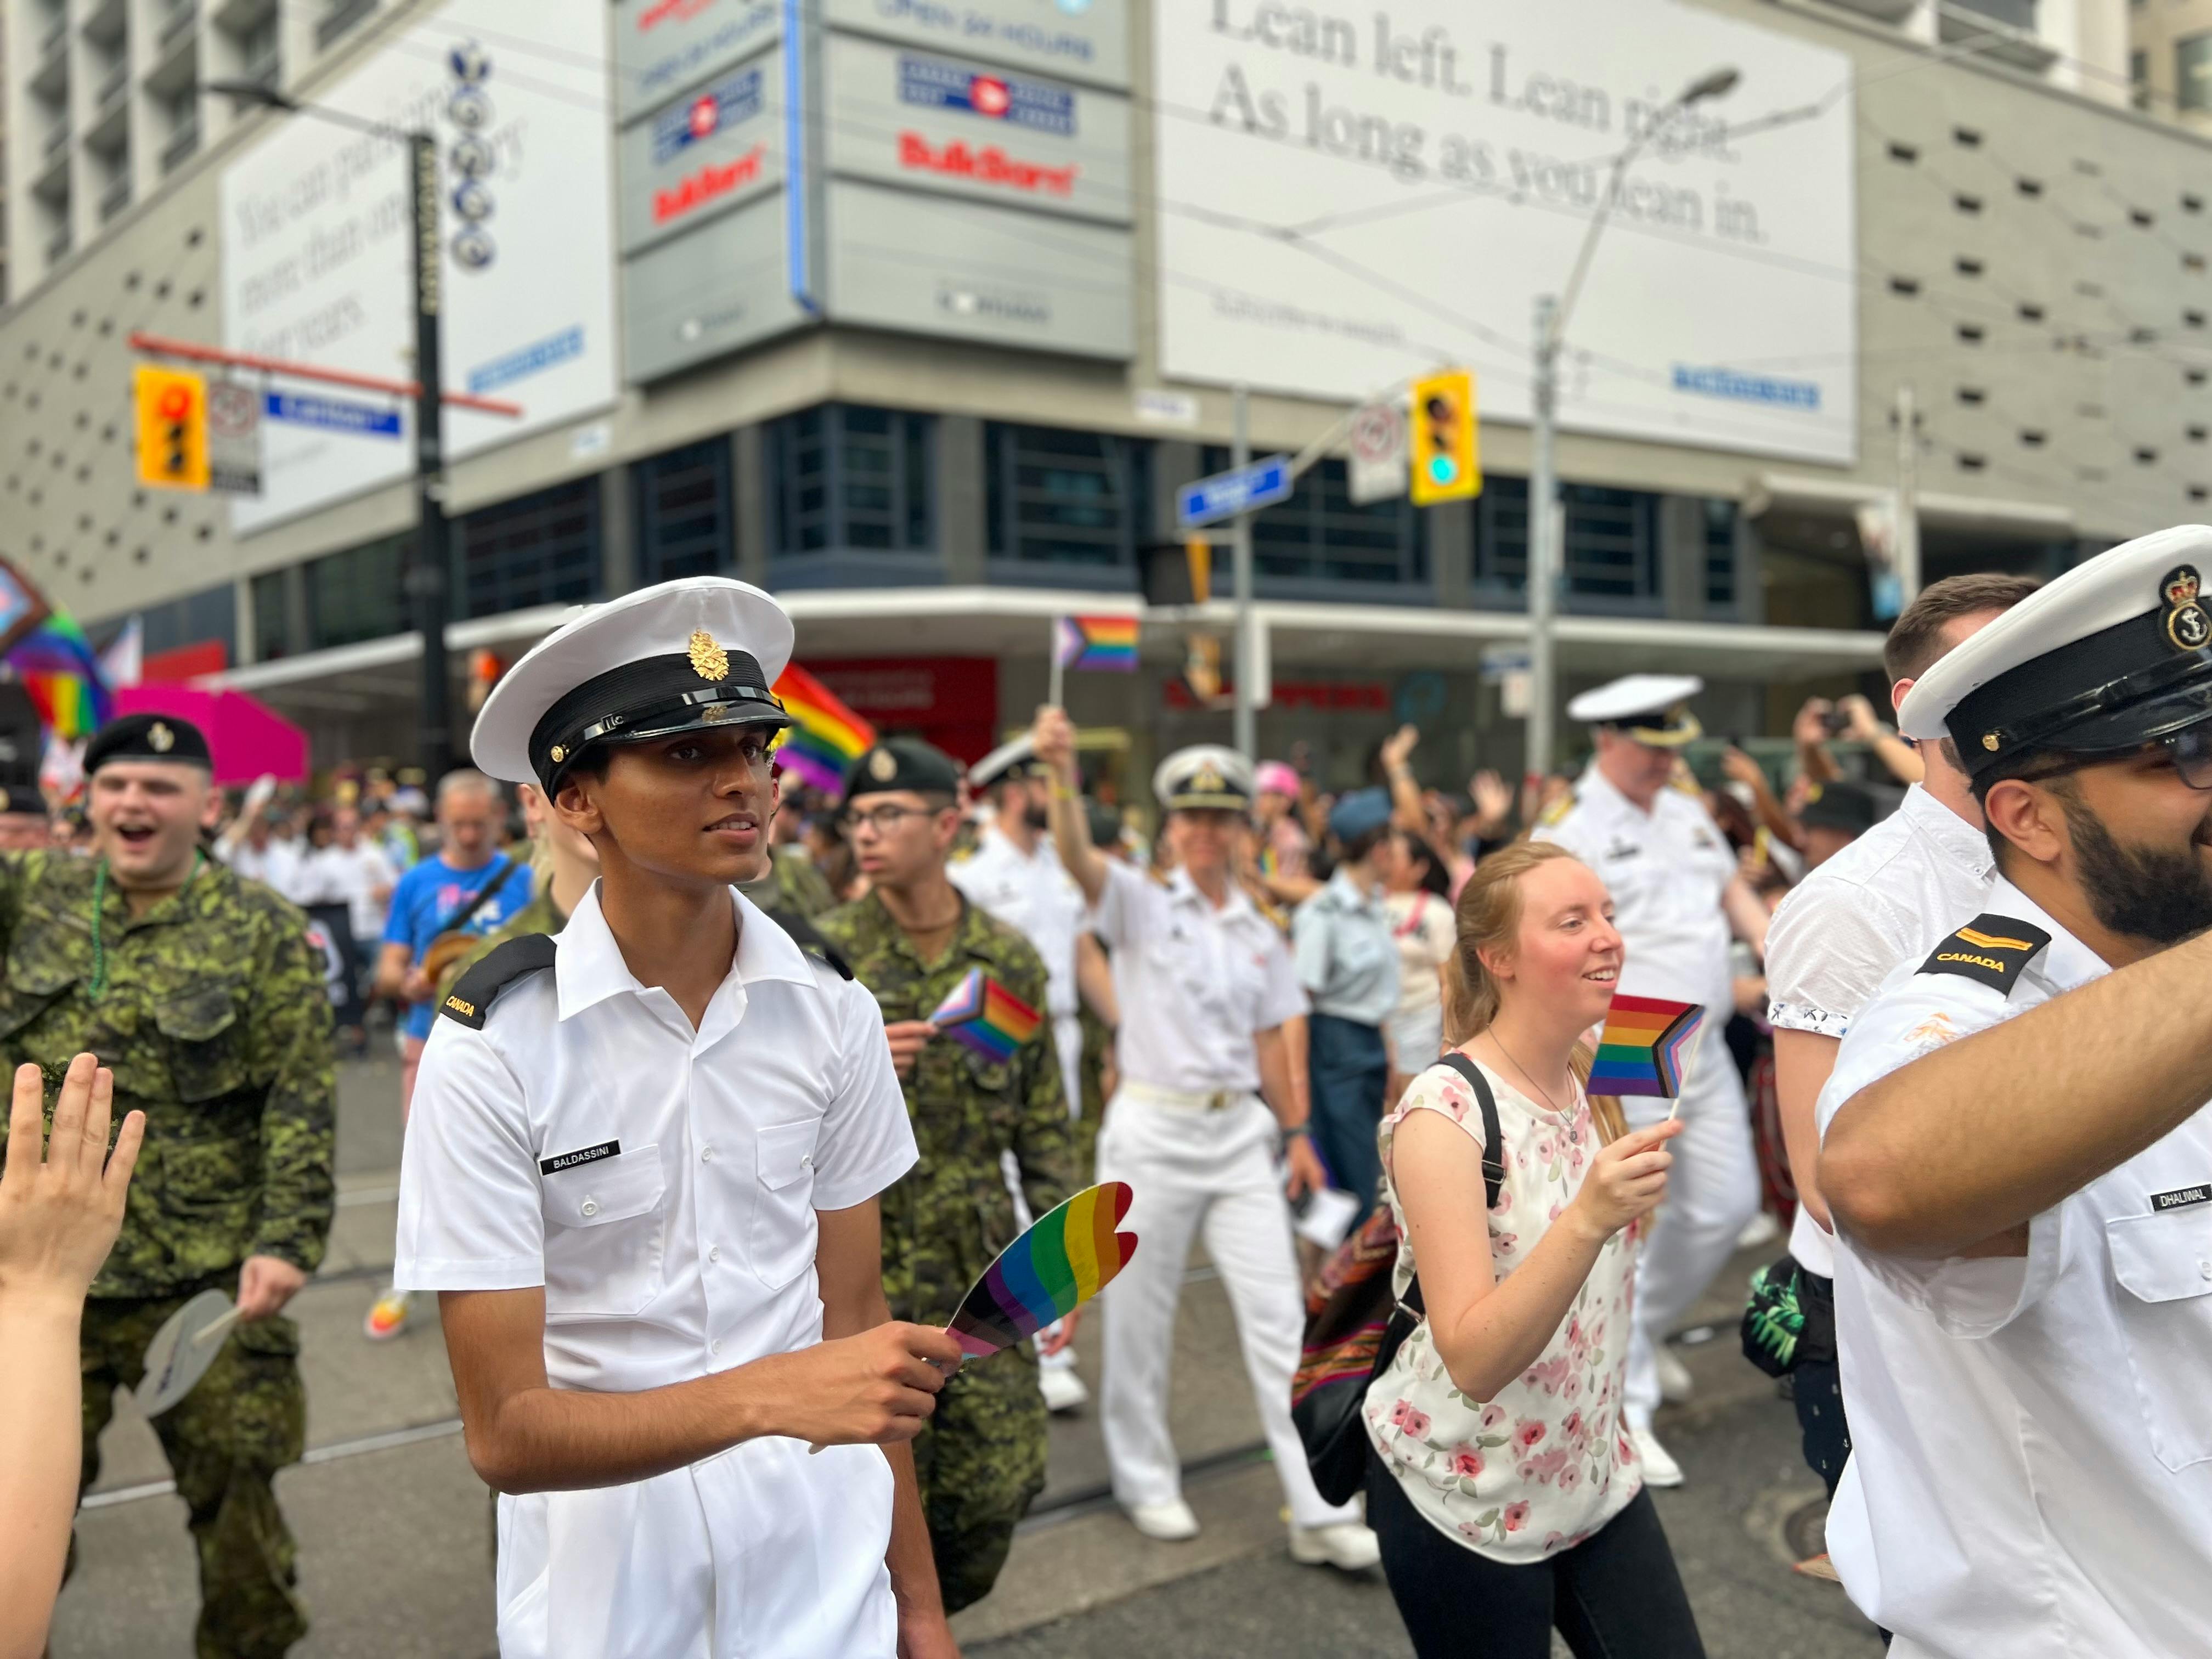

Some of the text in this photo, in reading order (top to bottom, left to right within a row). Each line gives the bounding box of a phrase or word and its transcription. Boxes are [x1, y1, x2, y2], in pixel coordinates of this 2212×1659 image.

[1209, 0, 1356, 67] Lean
[1375, 12, 1470, 97] left.
[1489, 44, 1611, 133] Lean
[1209, 62, 1289, 140] As
[1304, 84, 1426, 183] long
[1440, 135, 1496, 188] as
[1508, 148, 1598, 205] you
[1714, 180, 1770, 243] in.
[1936, 952, 2004, 973] CANADA
[446, 996, 475, 1017] CANADA
[553, 1146, 609, 1169] BALDASSINI
[2160, 1188, 2207, 1207] DHALIWAL
